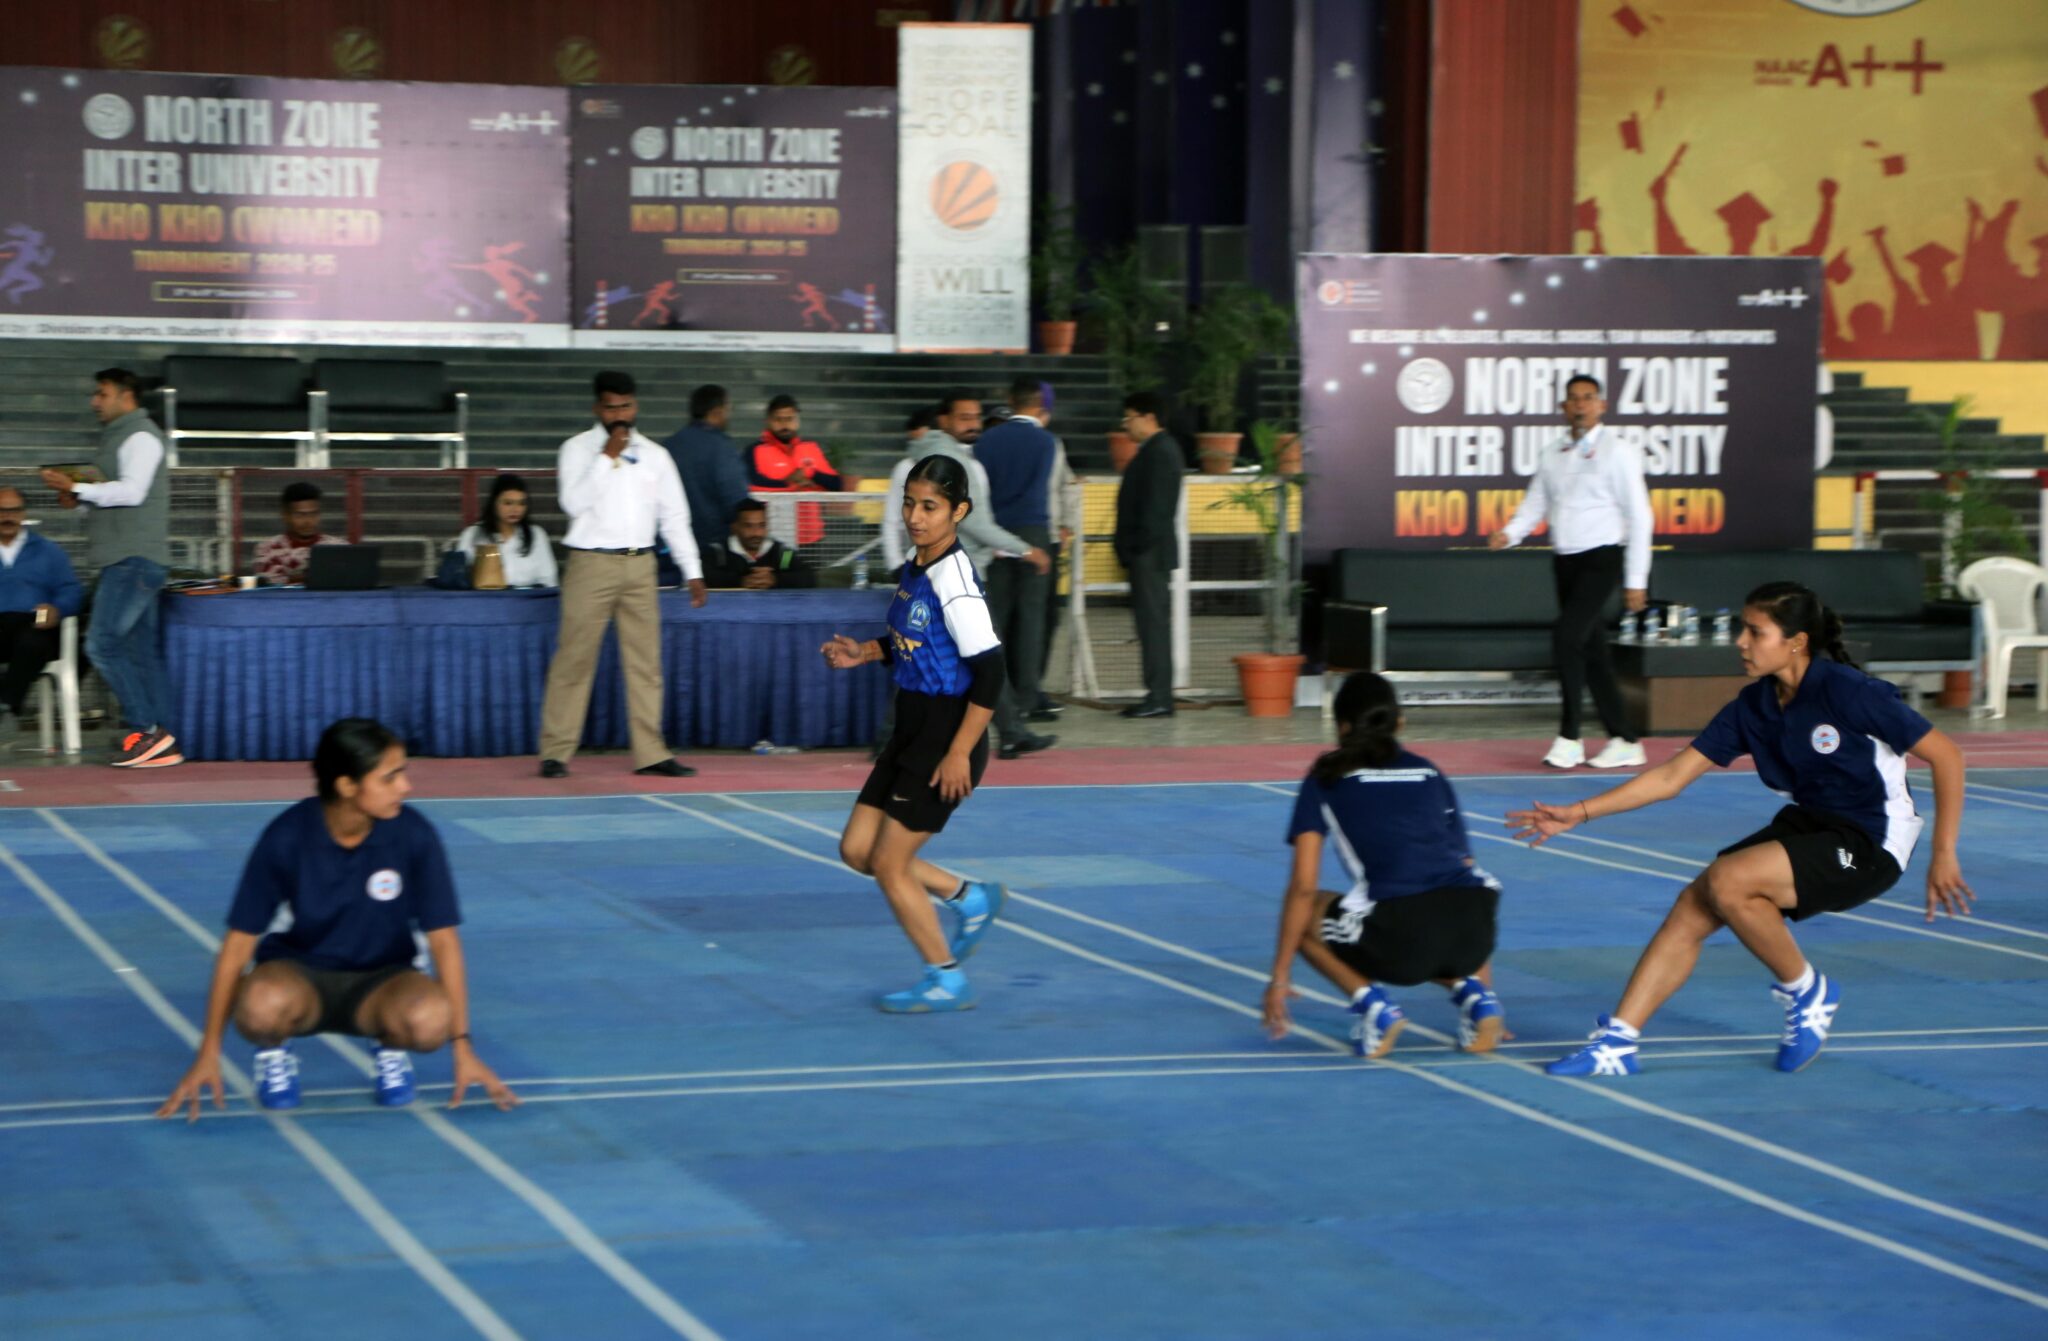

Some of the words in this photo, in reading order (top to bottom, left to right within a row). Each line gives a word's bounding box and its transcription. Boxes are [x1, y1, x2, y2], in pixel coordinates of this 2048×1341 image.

[1806, 37, 1945, 95] A++
[144, 95, 273, 145] NORTH
[282, 100, 382, 148] ZONE
[673, 126, 764, 161] NORTH
[770, 128, 842, 163] ZONE
[83, 148, 182, 193] INTER
[190, 153, 381, 198] UNIVERSITY
[630, 166, 699, 197] INTER
[703, 167, 841, 199] UNIVERSITY
[84, 201, 150, 241] KHO
[159, 203, 224, 243] KHO
[929, 268, 1014, 294] WILL
[1617, 357, 1729, 415] ZONE
[1395, 426, 1504, 476] INTER
[1395, 490, 1468, 537] KHO
[1476, 490, 1548, 537] KH
